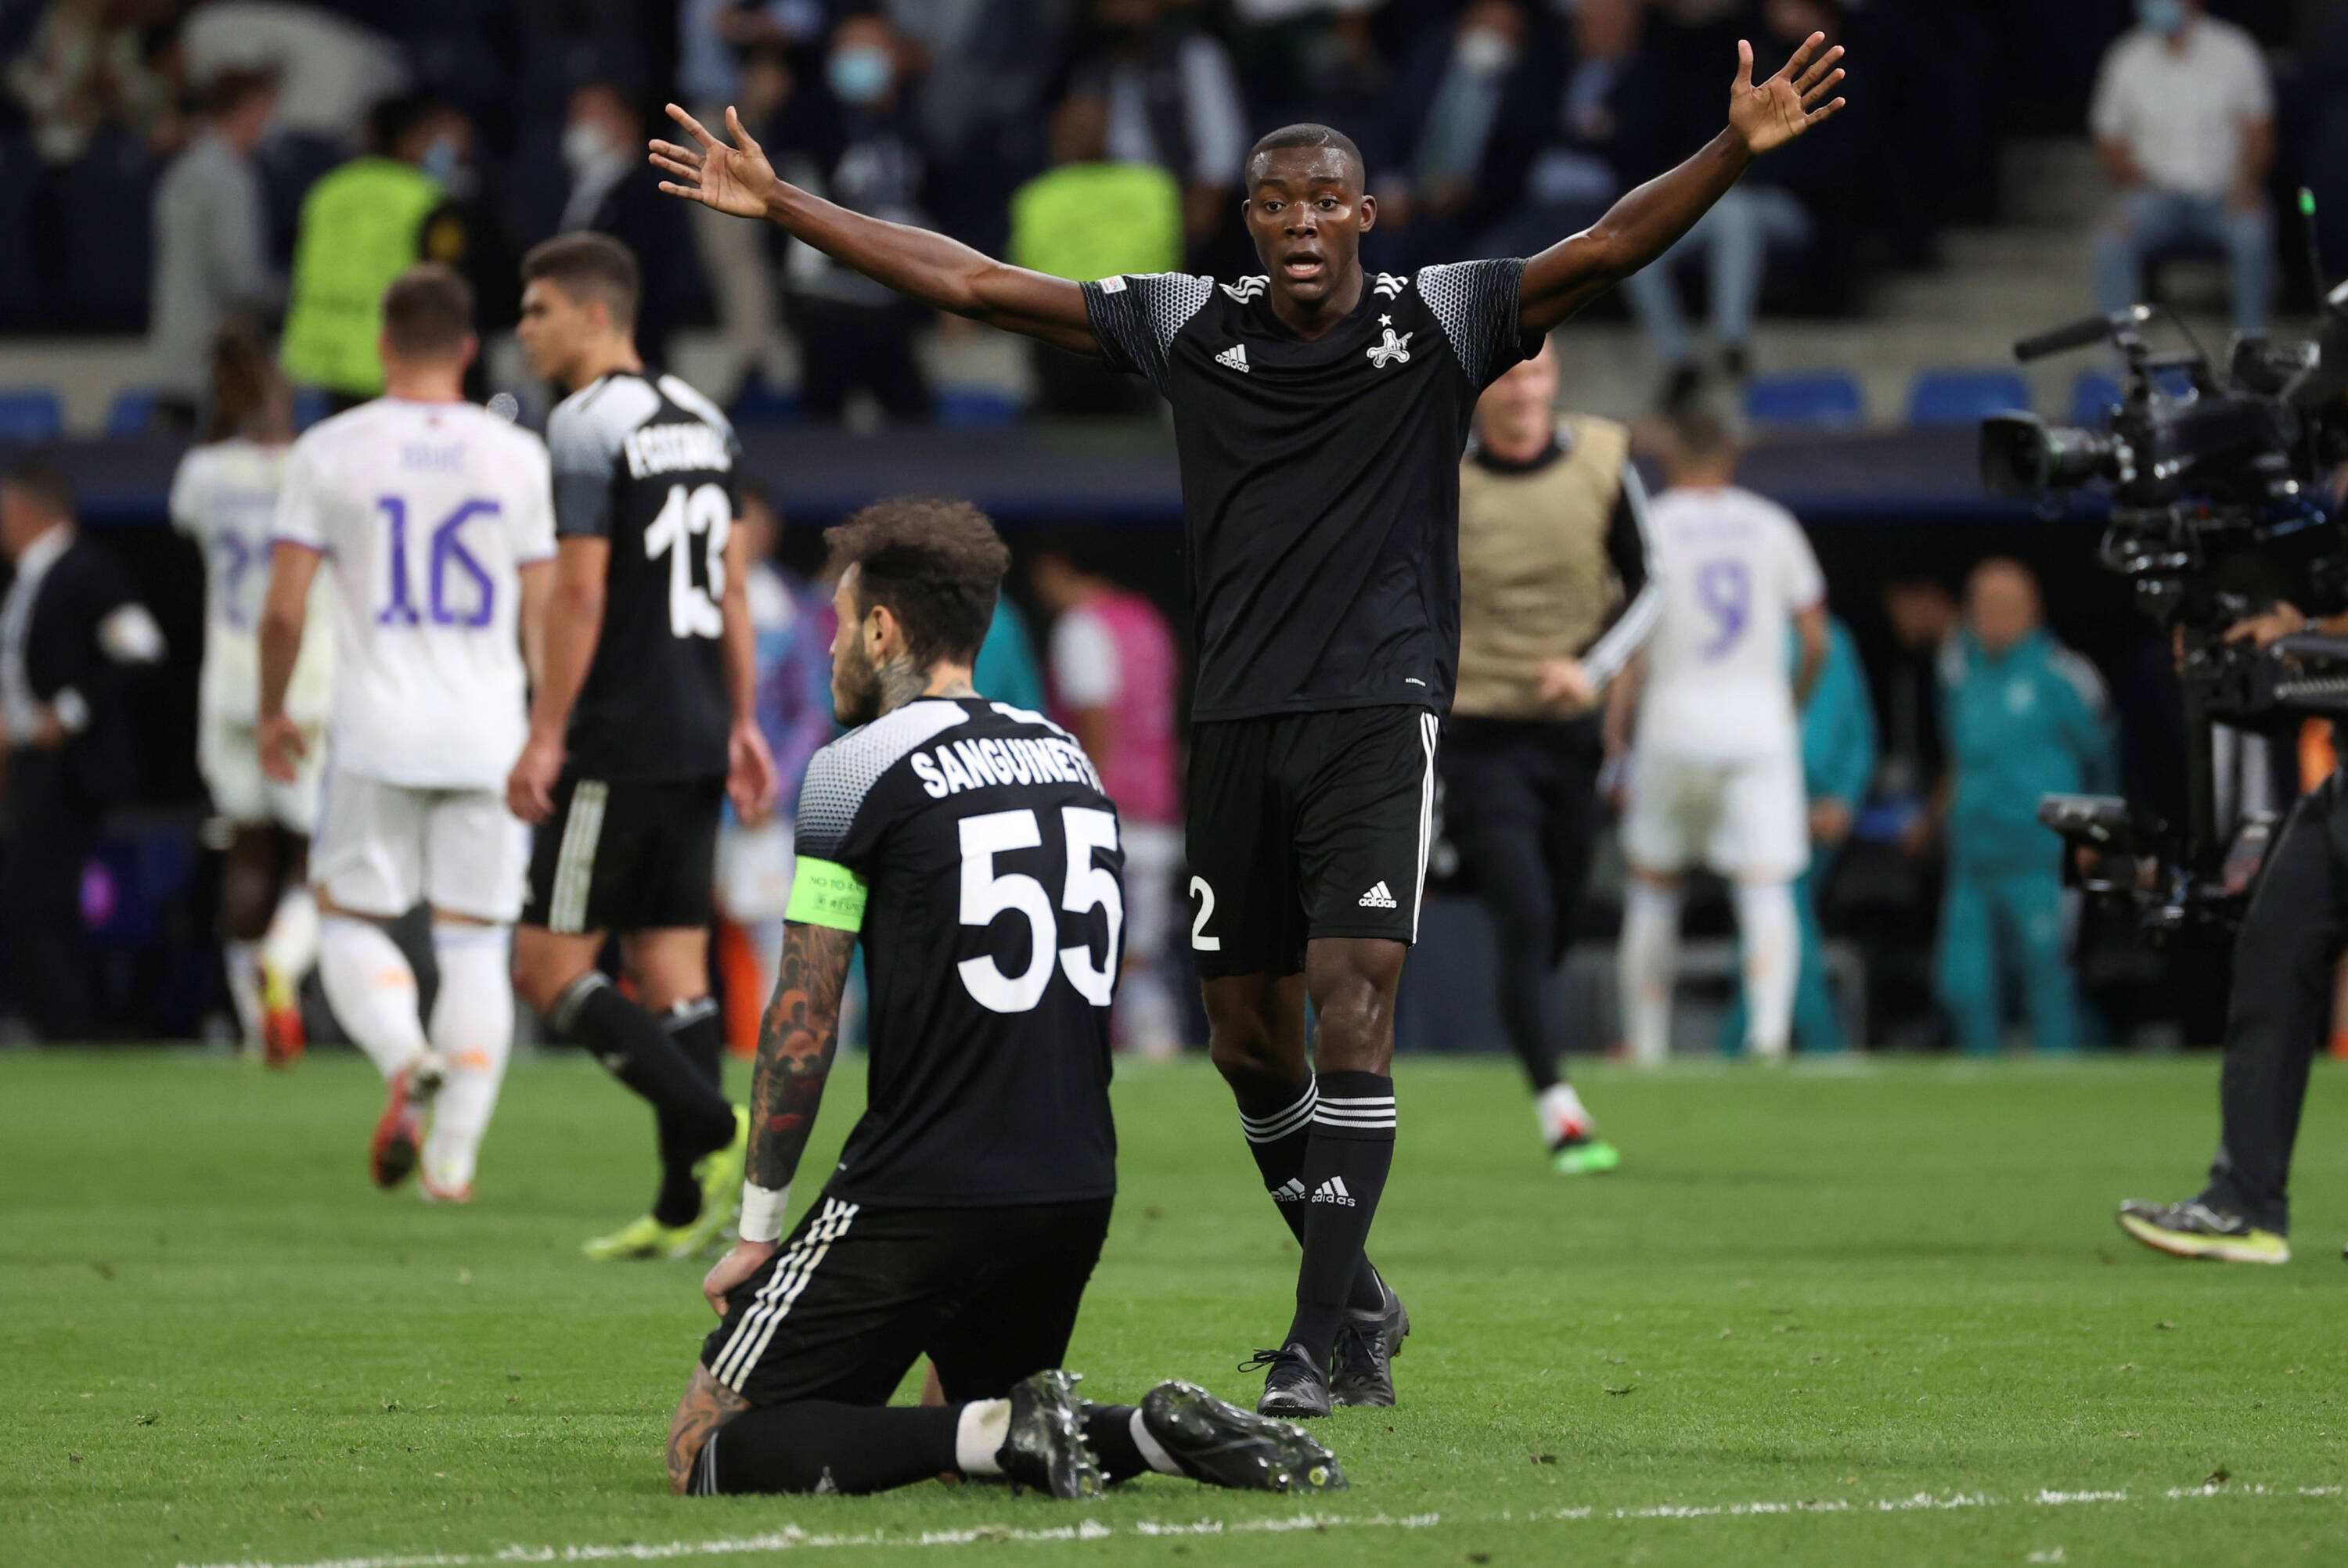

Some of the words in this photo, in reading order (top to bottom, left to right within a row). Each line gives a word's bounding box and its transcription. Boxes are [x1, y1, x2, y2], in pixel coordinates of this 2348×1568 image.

[1215, 354, 1250, 373] adidas
[377, 496, 500, 627] 16
[644, 483, 732, 638] 13
[1695, 560, 1752, 662] 9
[957, 806, 1124, 1013] 55
[1190, 876, 1220, 951] 2
[1359, 897, 1397, 908] adidas
[1311, 1194, 1356, 1207] adidas
